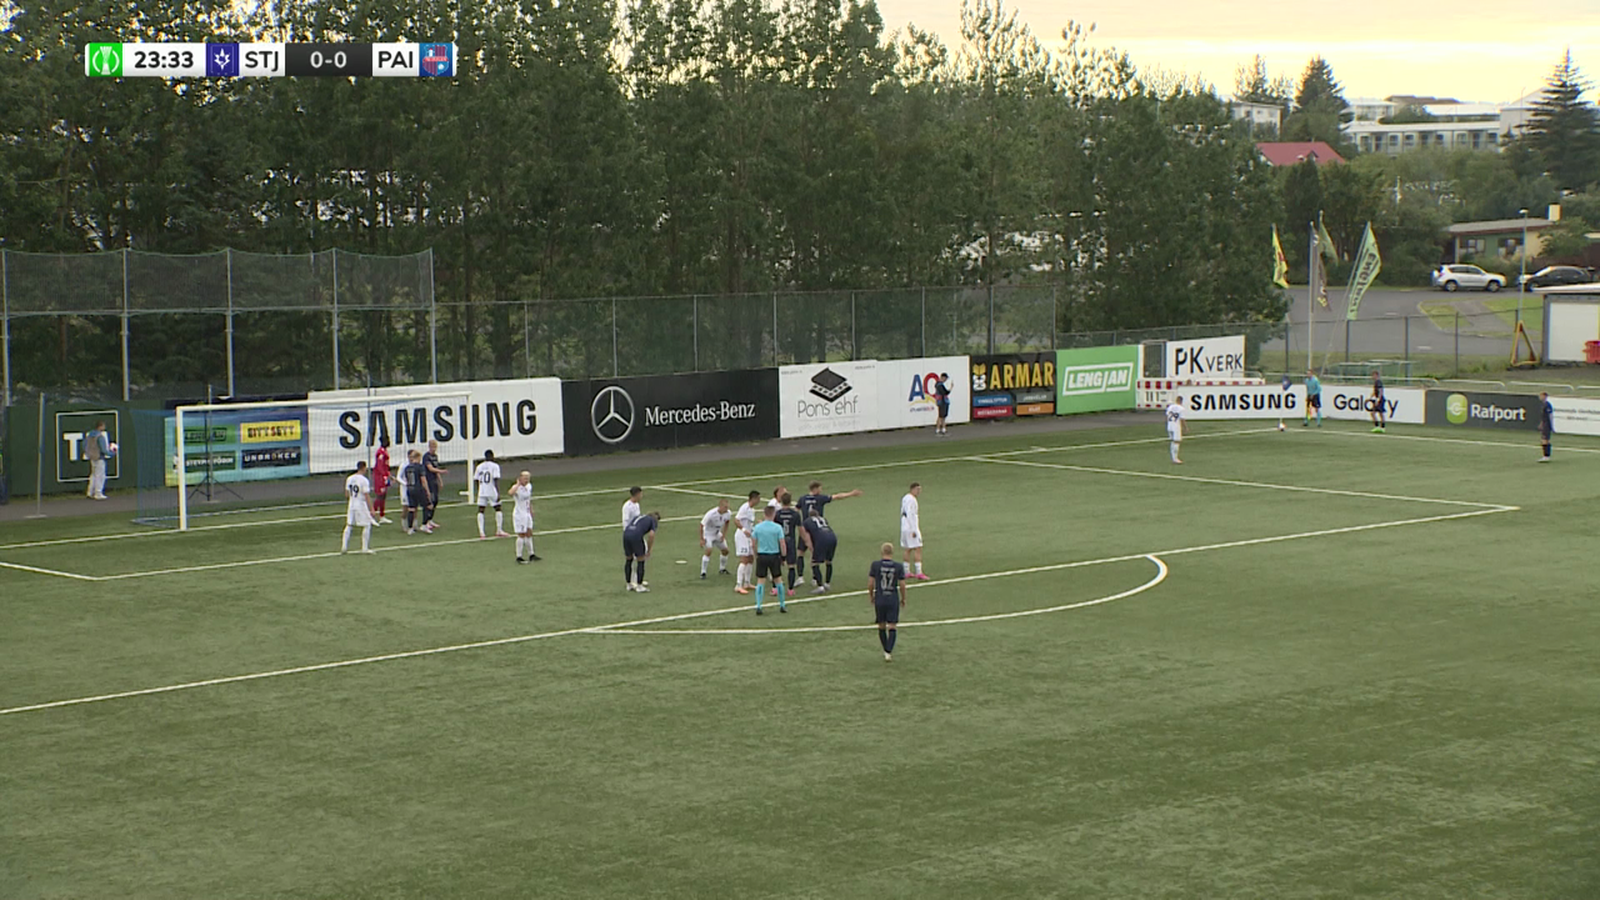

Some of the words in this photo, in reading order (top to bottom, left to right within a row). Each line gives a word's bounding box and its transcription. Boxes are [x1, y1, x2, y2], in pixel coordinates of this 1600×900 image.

[1174, 345, 1204, 375] PK
[1206, 353, 1243, 372] VERK
[989, 361, 1054, 390] ARMAR
[1068, 369, 1128, 391] LENGJAN
[797, 399, 831, 418] Pons
[1190, 392, 1296, 411] SAMSUNG
[645, 400, 756, 427] Mercedes-Benz
[1470, 403, 1526, 421] Rafport
[338, 399, 538, 449] SAMSUNG
[349, 484, 360, 498] 19
[880, 572, 895, 590] 32
